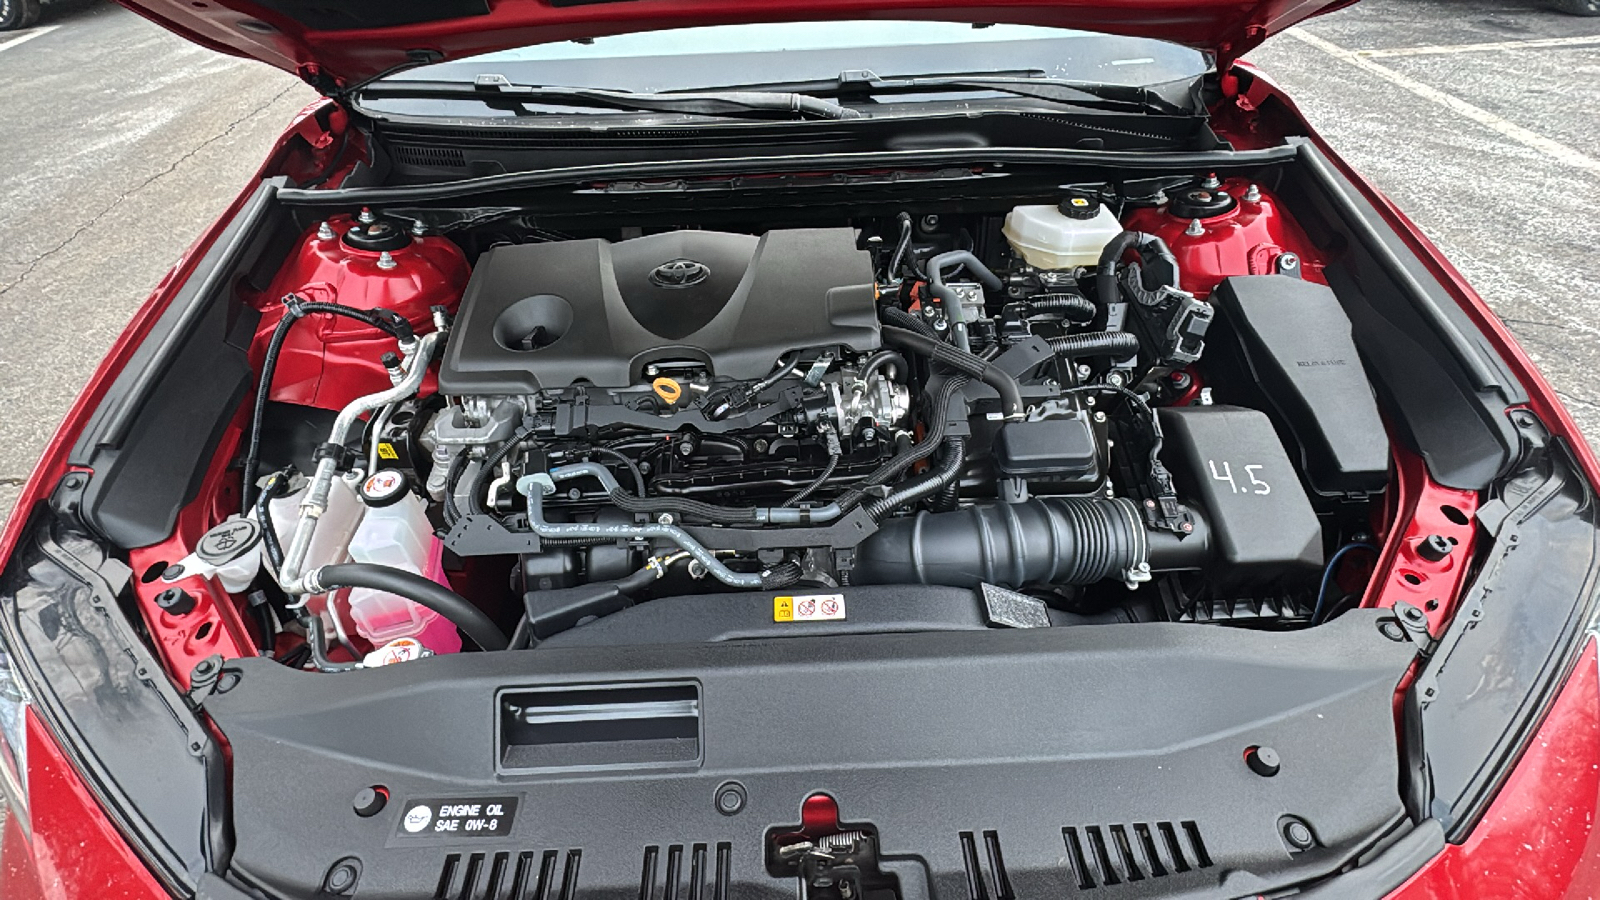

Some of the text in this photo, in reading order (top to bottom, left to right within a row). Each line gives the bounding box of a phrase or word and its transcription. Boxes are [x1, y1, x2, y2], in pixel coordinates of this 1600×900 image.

[1208, 459, 1271, 495] 4.5
[439, 804, 504, 817] ENGINE OIL
[434, 819, 498, 832] SAE 0W-8
